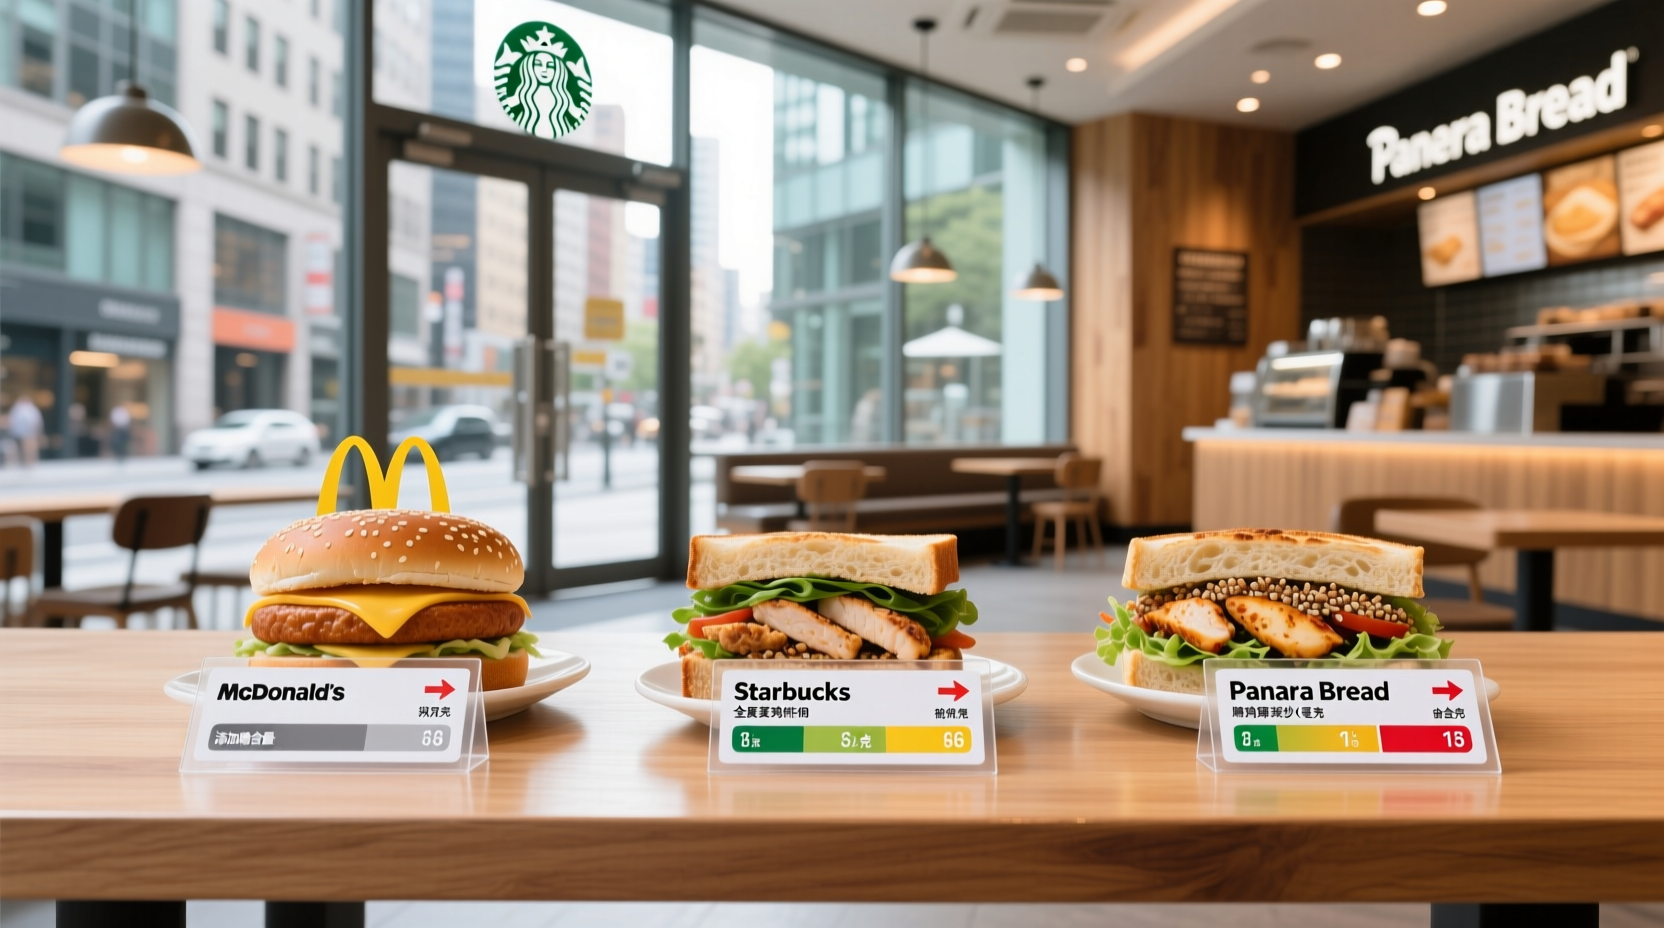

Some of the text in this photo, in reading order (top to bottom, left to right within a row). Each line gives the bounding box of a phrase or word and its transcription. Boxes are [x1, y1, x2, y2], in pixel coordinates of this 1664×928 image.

[1366, 50, 1628, 185] Panera Bread
[216, 683, 345, 701] McDonald's
[734, 682, 851, 701] Starbucks
[1229, 681, 1390, 701] Panara Bread
